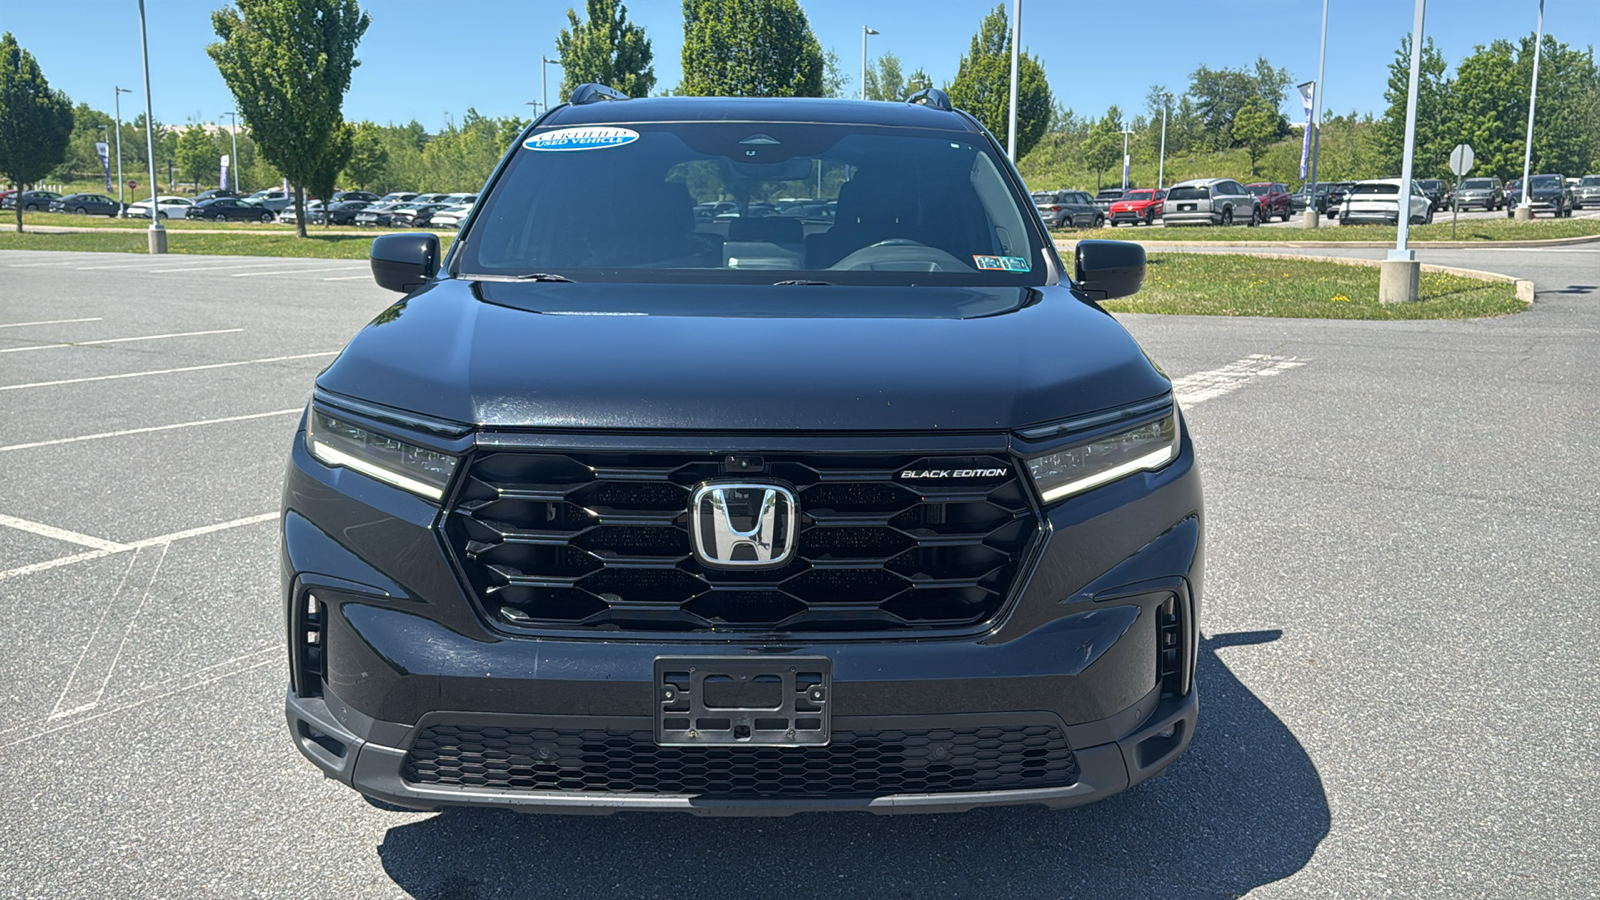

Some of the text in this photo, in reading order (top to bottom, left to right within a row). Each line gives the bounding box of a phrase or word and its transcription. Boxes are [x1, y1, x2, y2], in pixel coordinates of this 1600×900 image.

[539, 131, 627, 140] CERTIFIED
[535, 136, 624, 147] USED VEHICLE
[901, 468, 1007, 478] BLACK EDITION
